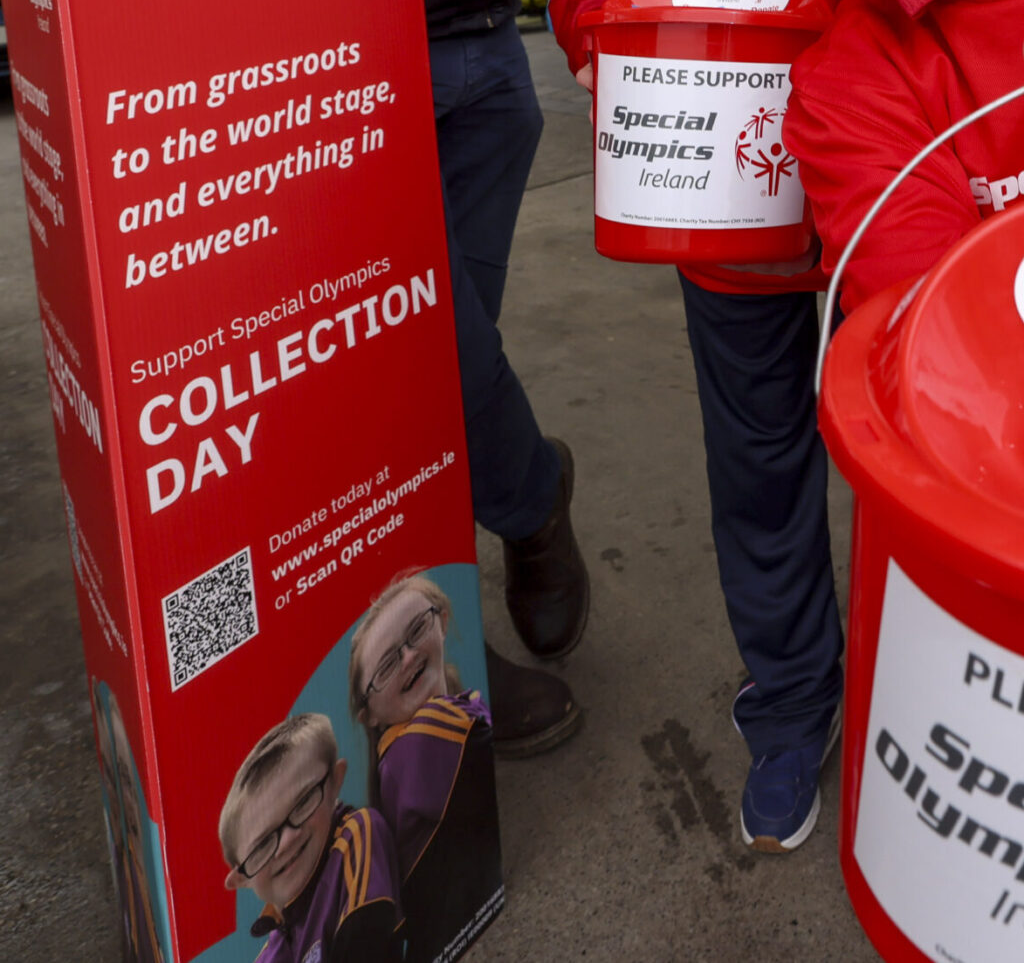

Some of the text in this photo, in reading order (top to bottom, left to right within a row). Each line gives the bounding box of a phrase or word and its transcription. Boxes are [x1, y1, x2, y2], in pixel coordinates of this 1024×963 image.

[105, 41, 361, 124] From grassroots
[612, 105, 718, 131] Special
[623, 65, 786, 89] PLEASE SUPPORT
[111, 81, 397, 179] to the world stage,
[598, 131, 715, 163] Olympics
[117, 126, 385, 233] and everything in
[639, 168, 711, 190] Ireland
[124, 214, 279, 289] between.
[130, 327, 225, 384] Support
[230, 290, 306, 340] Special
[309, 255, 391, 305] Olympics
[138, 268, 438, 446] COLLECTION
[145, 412, 260, 515] DAY
[268, 465, 391, 554] Donate today at
[271, 451, 455, 582] www.specialolympics.ie
[274, 512, 405, 610] or Scan QR Code
